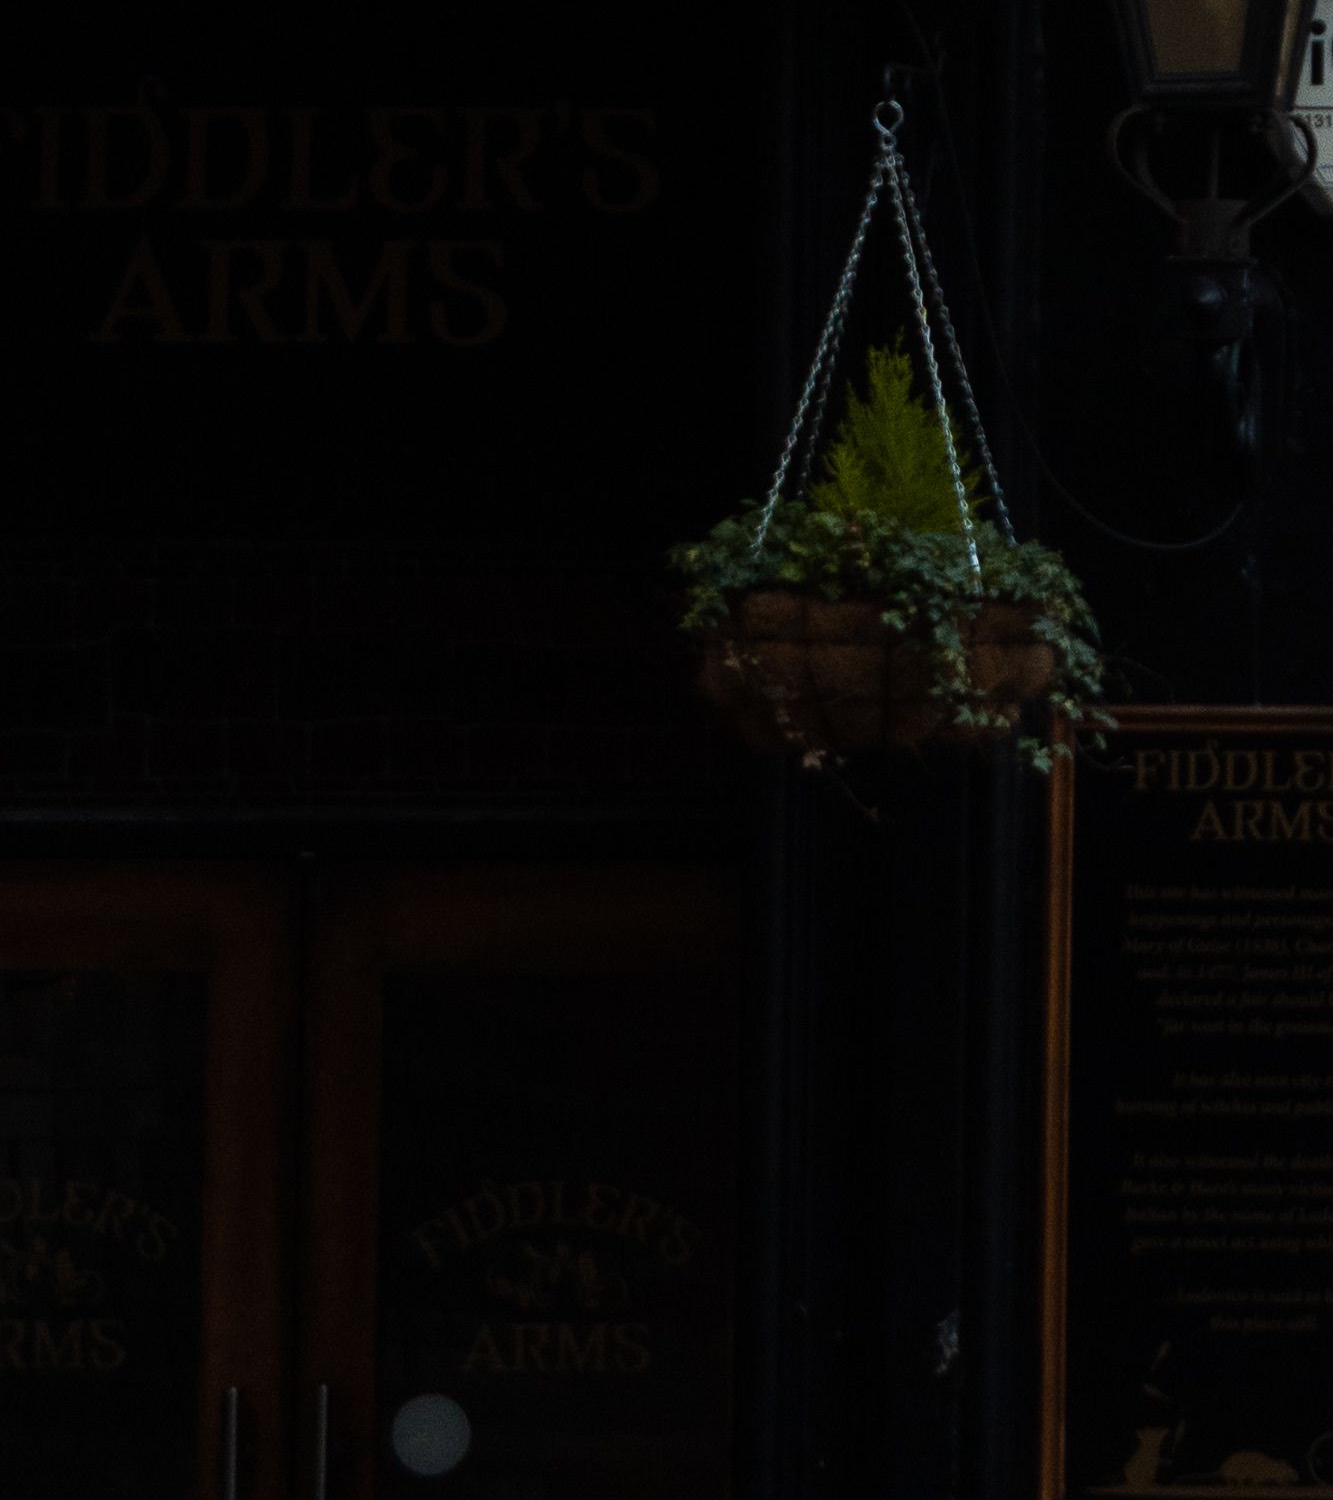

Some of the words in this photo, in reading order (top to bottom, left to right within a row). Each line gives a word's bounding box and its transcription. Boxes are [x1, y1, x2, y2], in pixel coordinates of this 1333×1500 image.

[0, 78, 662, 215] IDDLER'S
[89, 234, 510, 349] ARMS
[460, 1322, 653, 1374] ARMS
